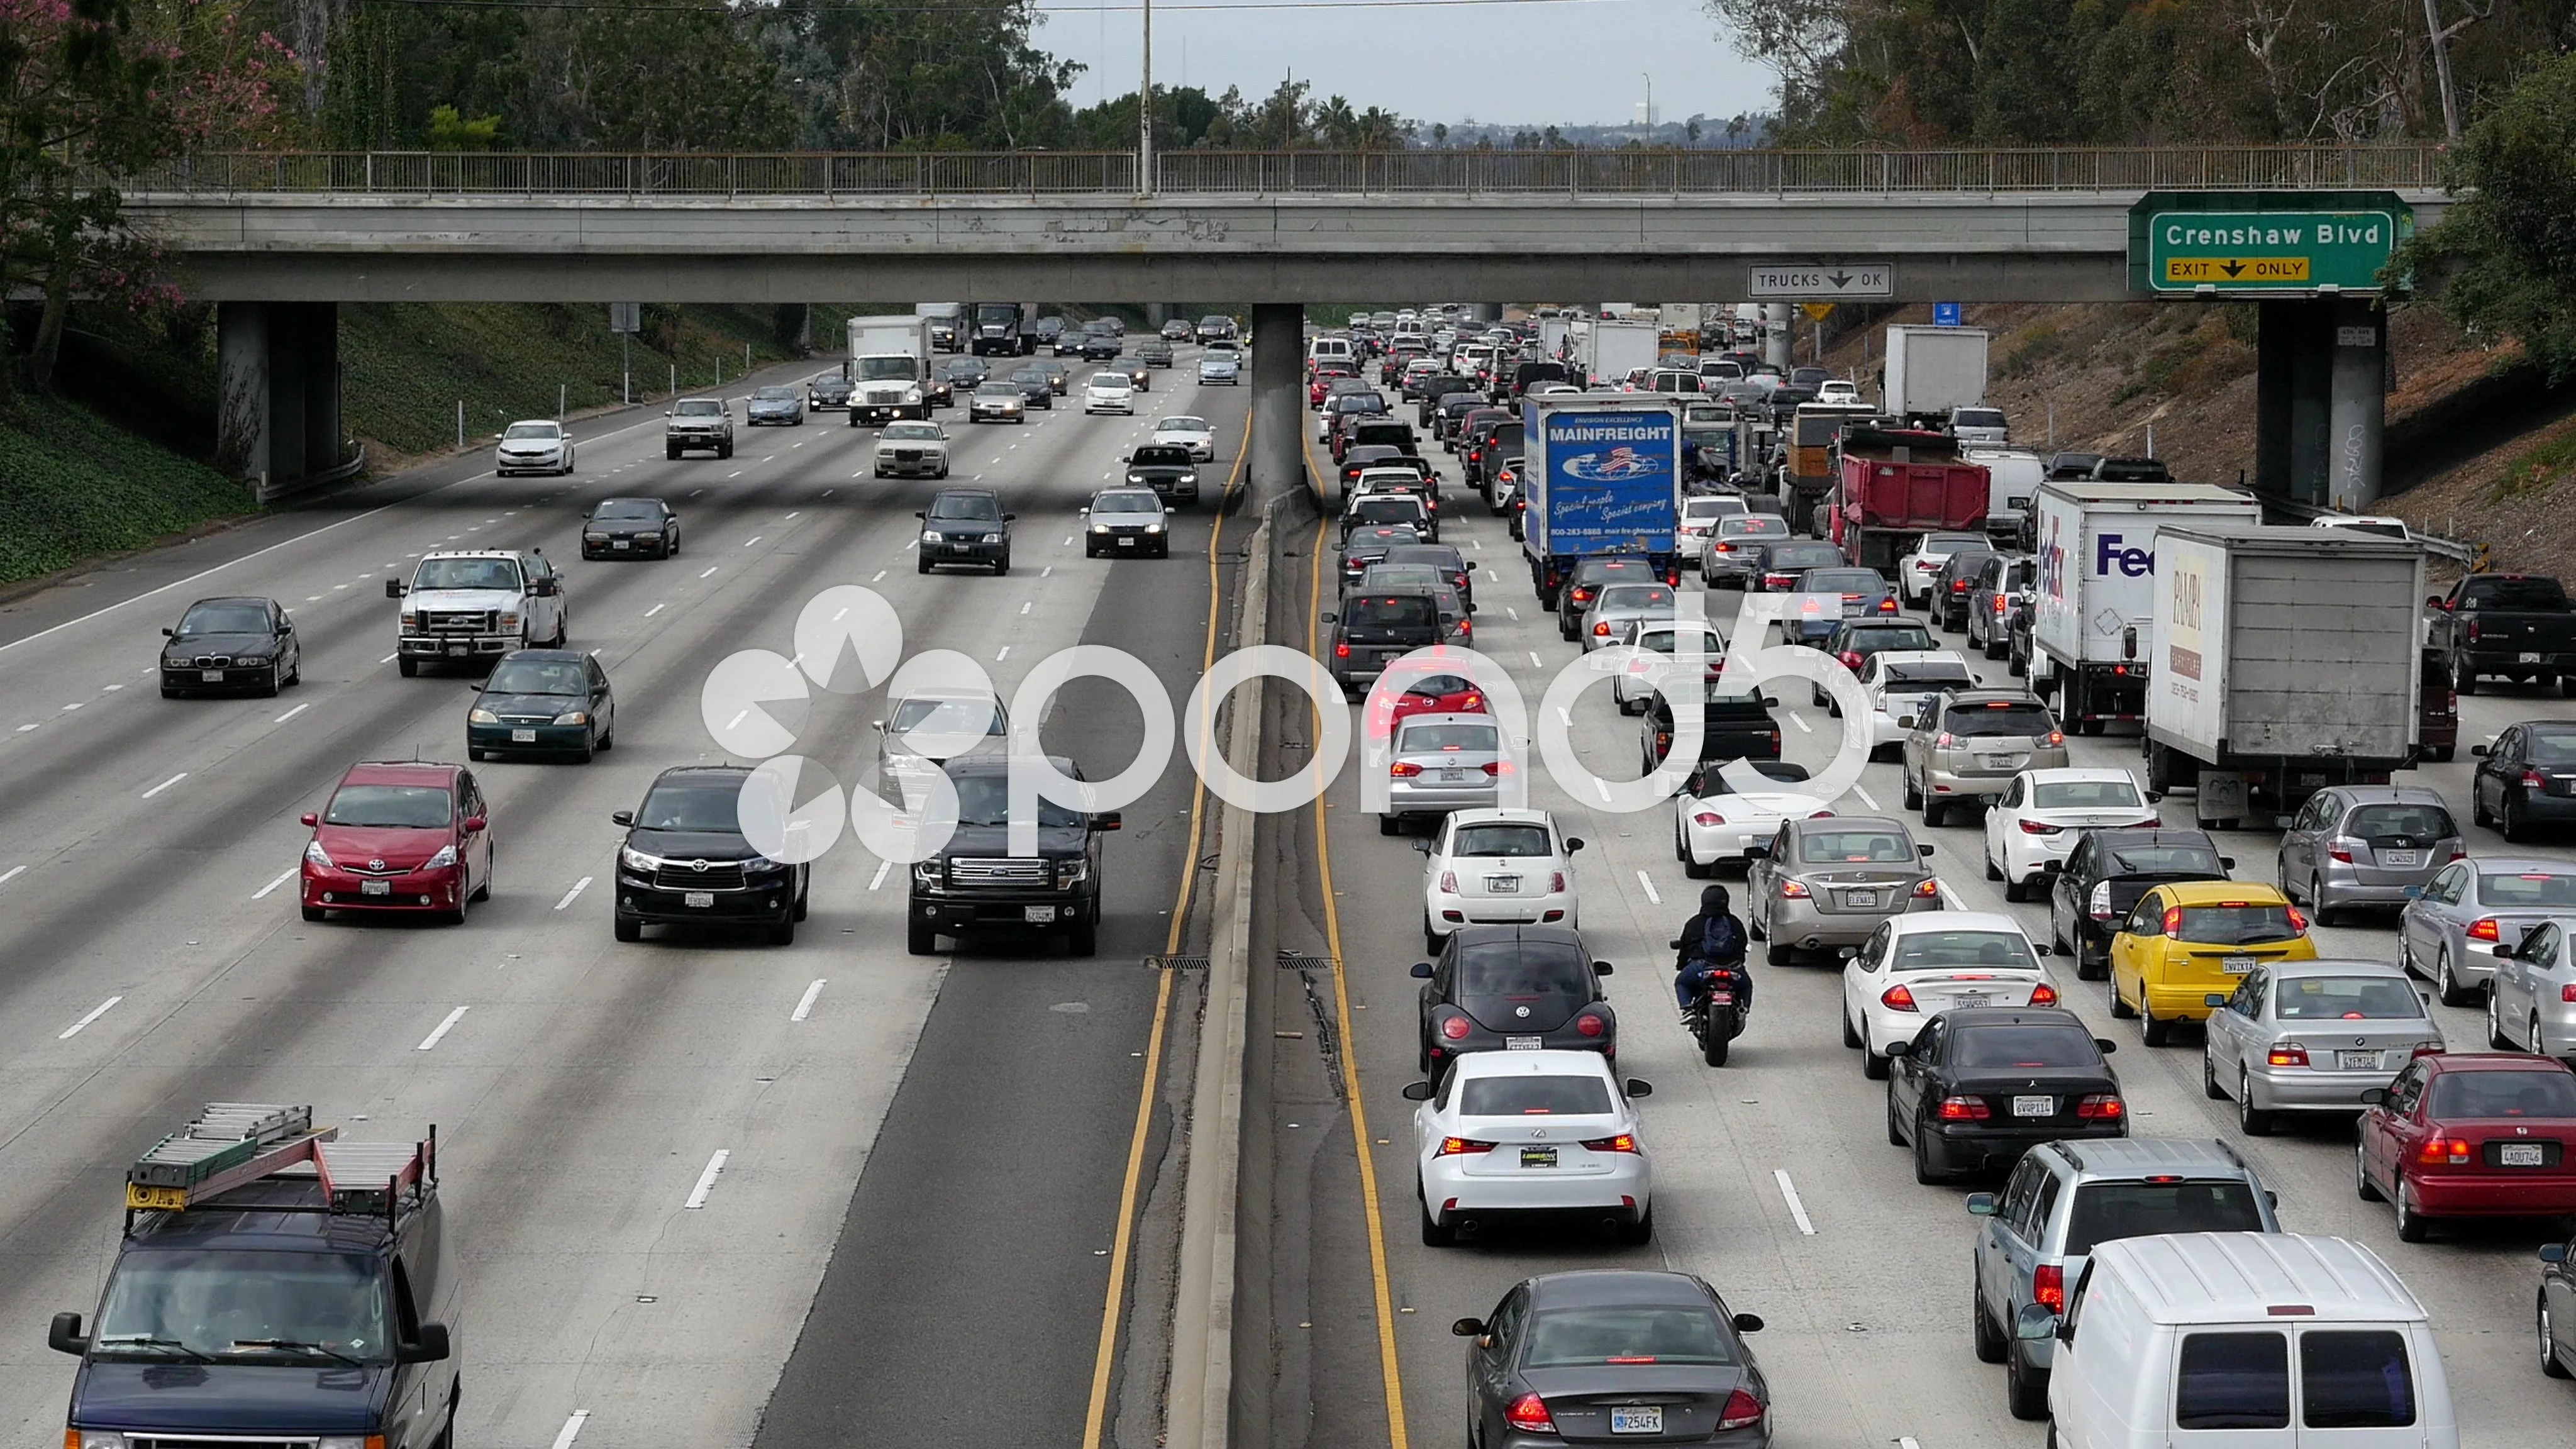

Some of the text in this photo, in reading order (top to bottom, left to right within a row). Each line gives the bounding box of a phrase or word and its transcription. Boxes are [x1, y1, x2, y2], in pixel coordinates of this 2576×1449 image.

[2166, 224, 2379, 245] Crenshaw Blvd
[2171, 263, 2303, 275] EXIT ONLY
[1758, 274, 1882, 287] TRUCKS OK
[1550, 426, 1670, 441] MAINFREIGHT
[1553, 494, 1587, 519] Special
[1601, 500, 1633, 524] Special
[2097, 534, 2155, 577] Fe
[2173, 570, 2201, 631] PAMPA
